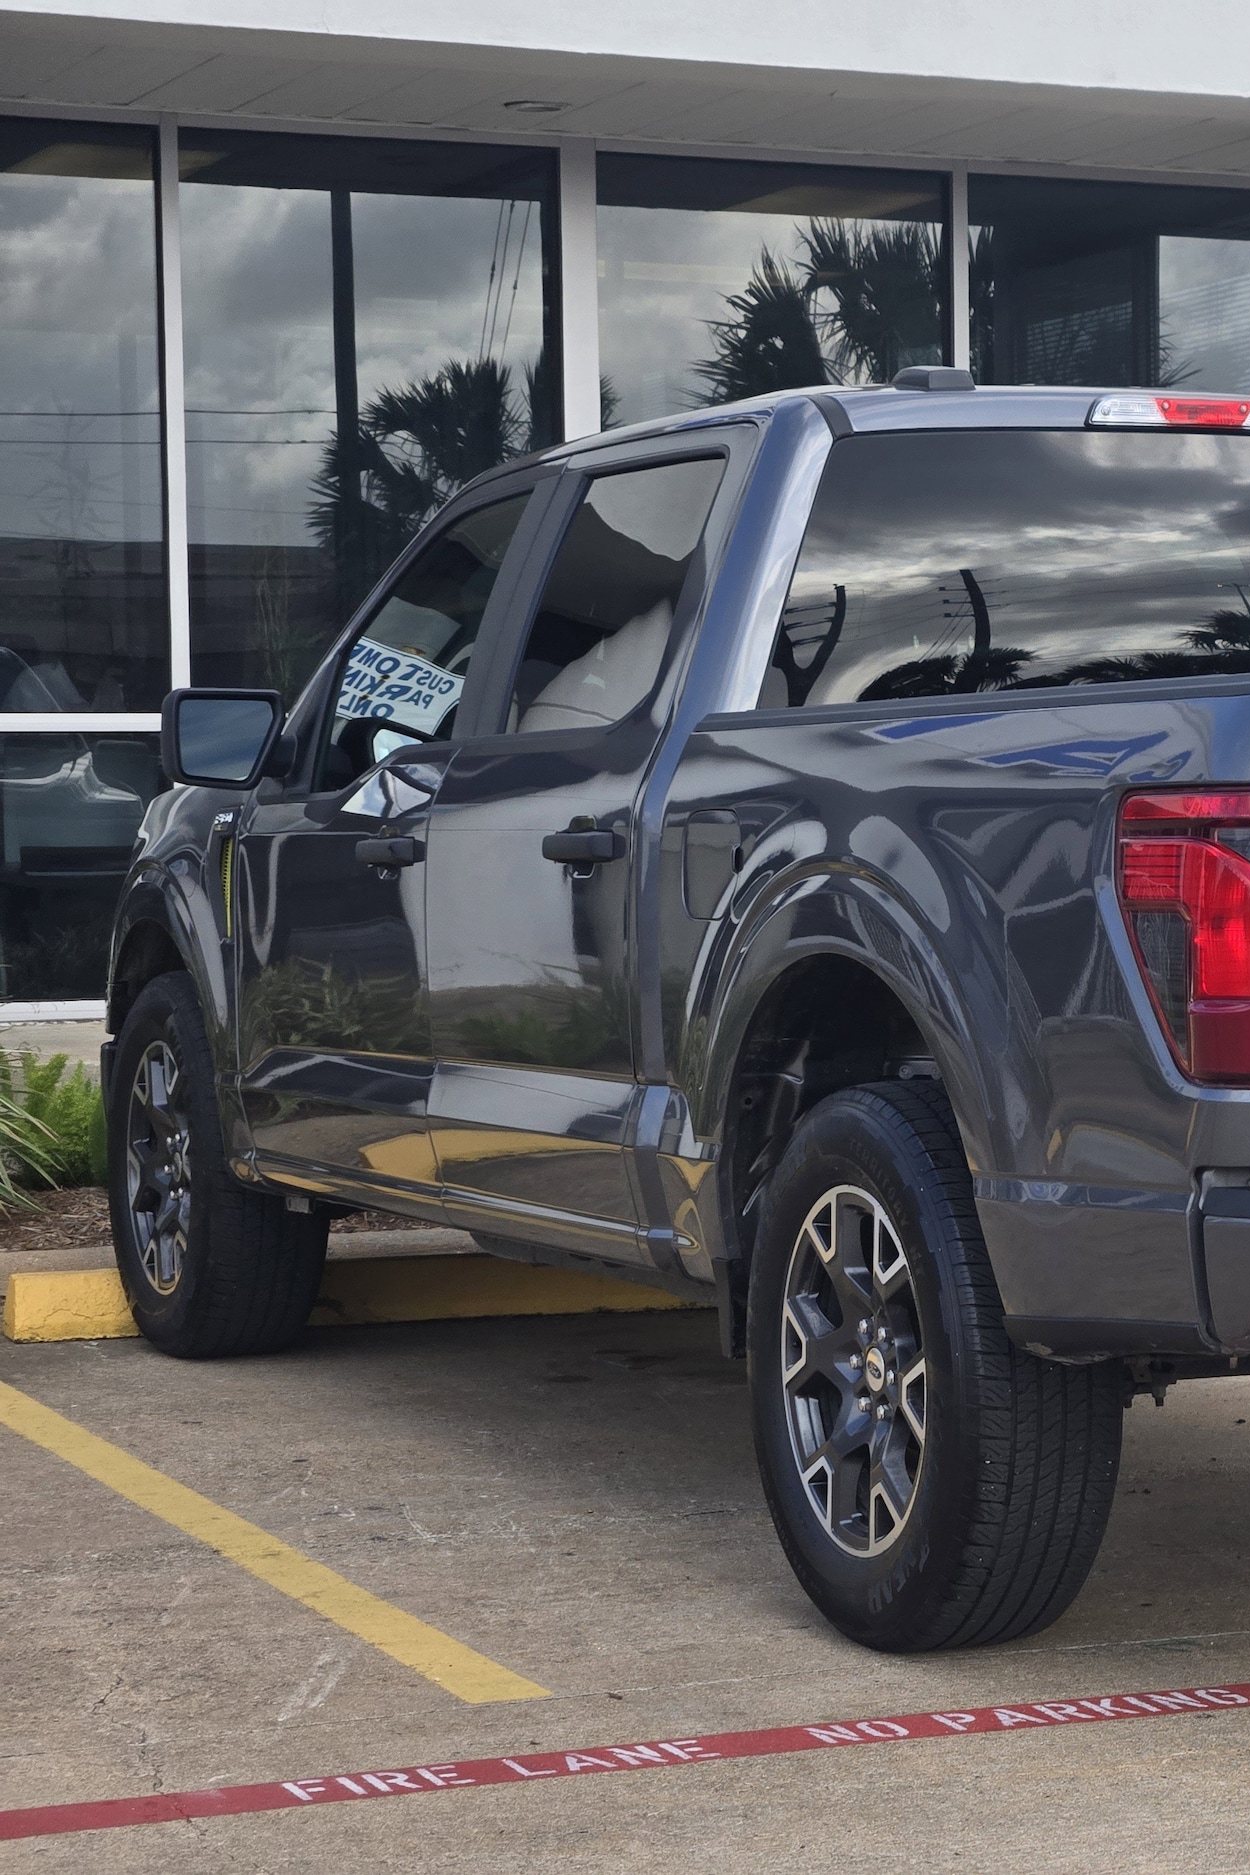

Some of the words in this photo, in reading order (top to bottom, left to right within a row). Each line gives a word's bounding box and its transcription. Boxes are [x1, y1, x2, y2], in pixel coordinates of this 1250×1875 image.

[281, 1764, 476, 1801] FIRE
[502, 1739, 722, 1777] LANE
[803, 1719, 909, 1744] NO
[931, 1688, 1249, 1732] PARKING
